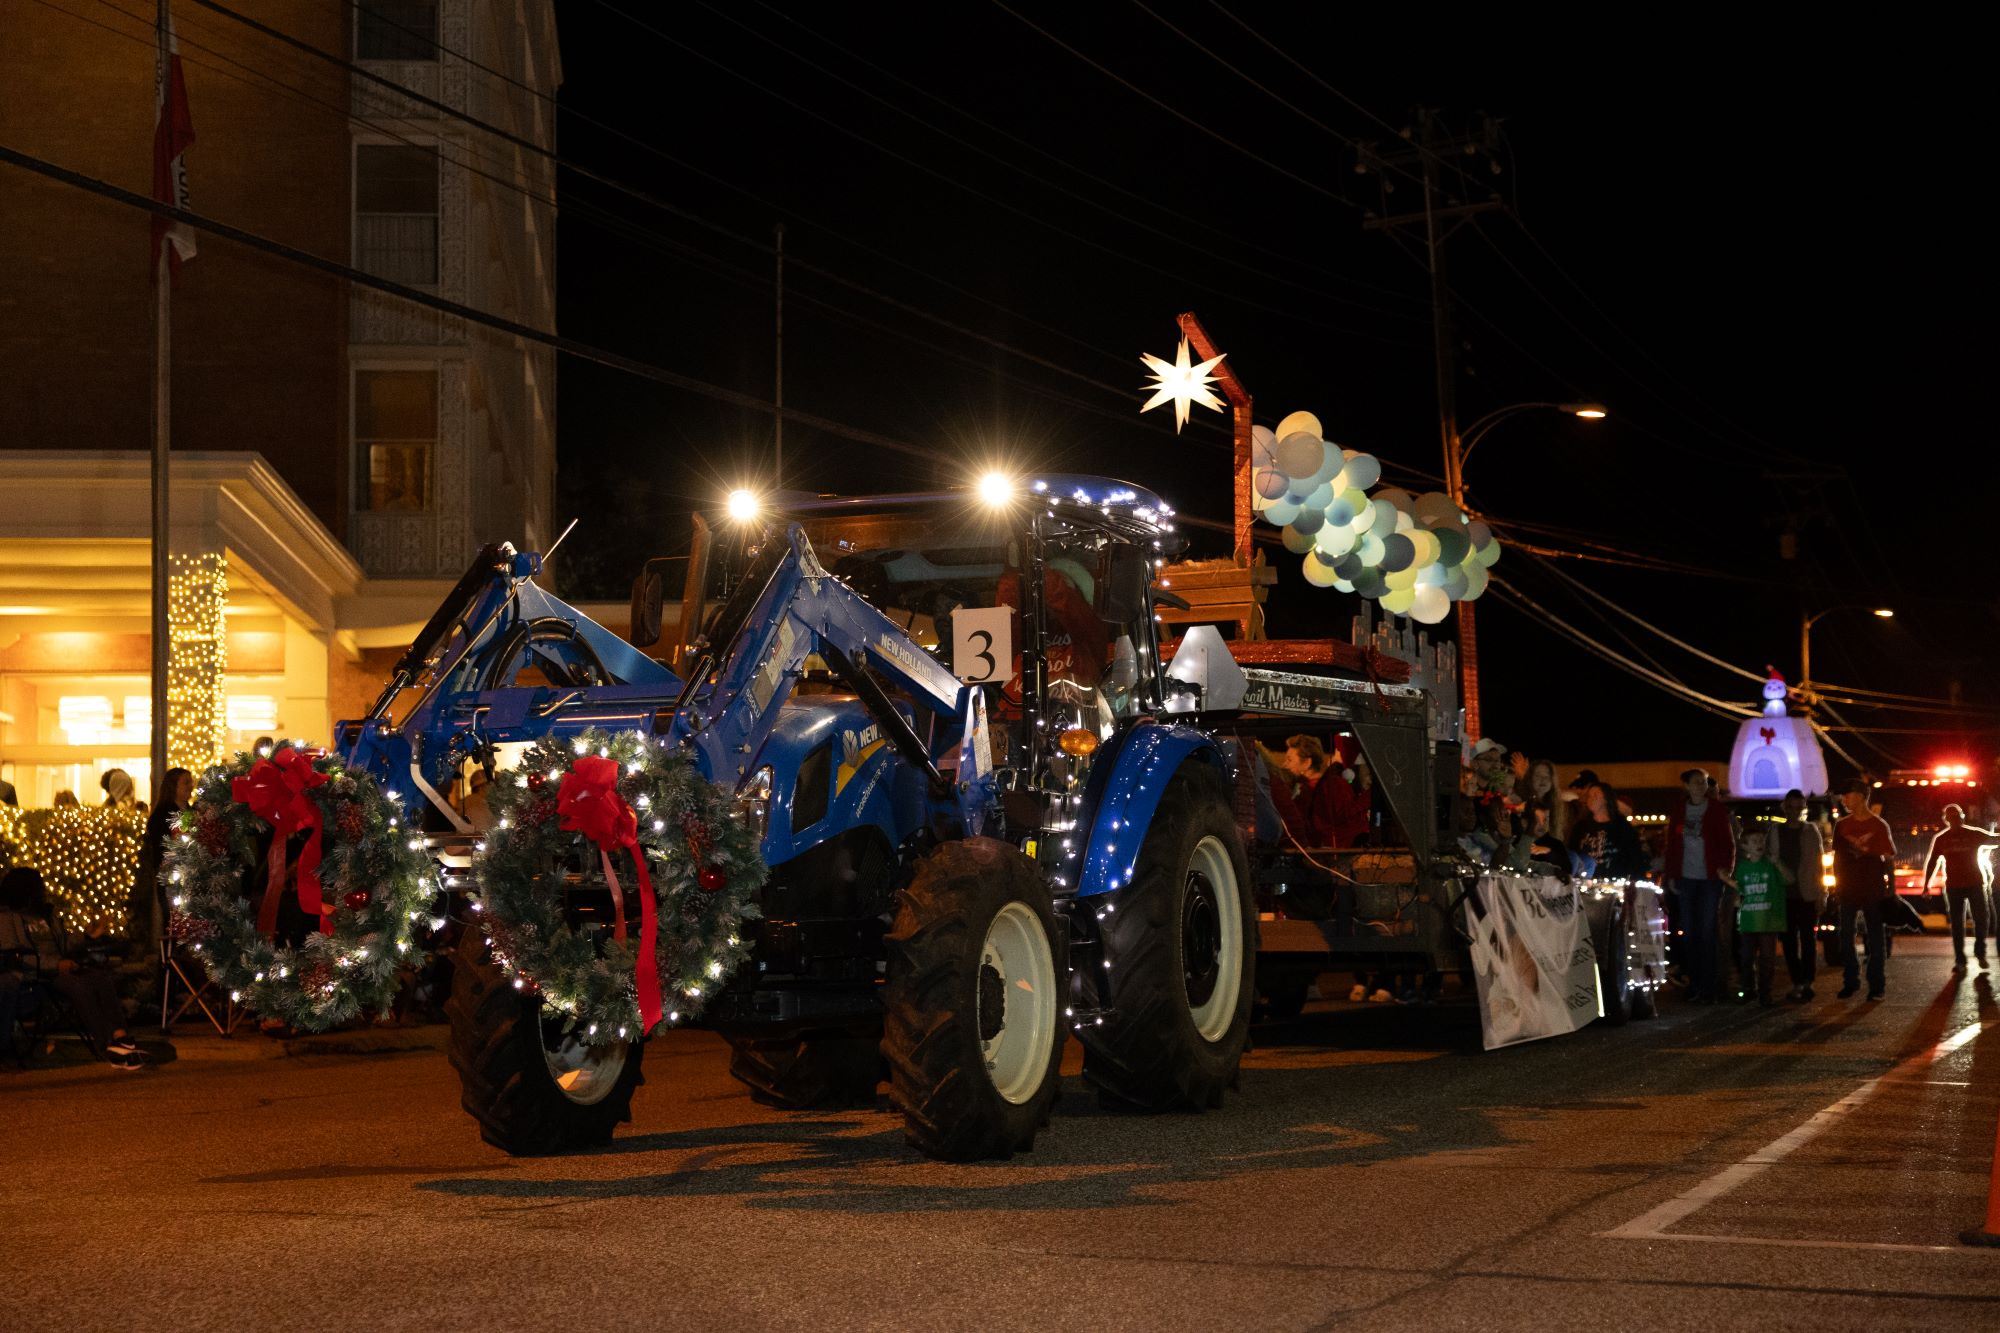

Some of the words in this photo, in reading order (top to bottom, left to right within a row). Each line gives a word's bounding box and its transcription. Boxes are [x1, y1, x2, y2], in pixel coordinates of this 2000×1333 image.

[881, 633, 899, 657] NEW
[898, 646, 933, 677] HOLLAND
[967, 630, 996, 681] 3
[1243, 687, 1266, 704] rail
[860, 723, 878, 748] NEW
